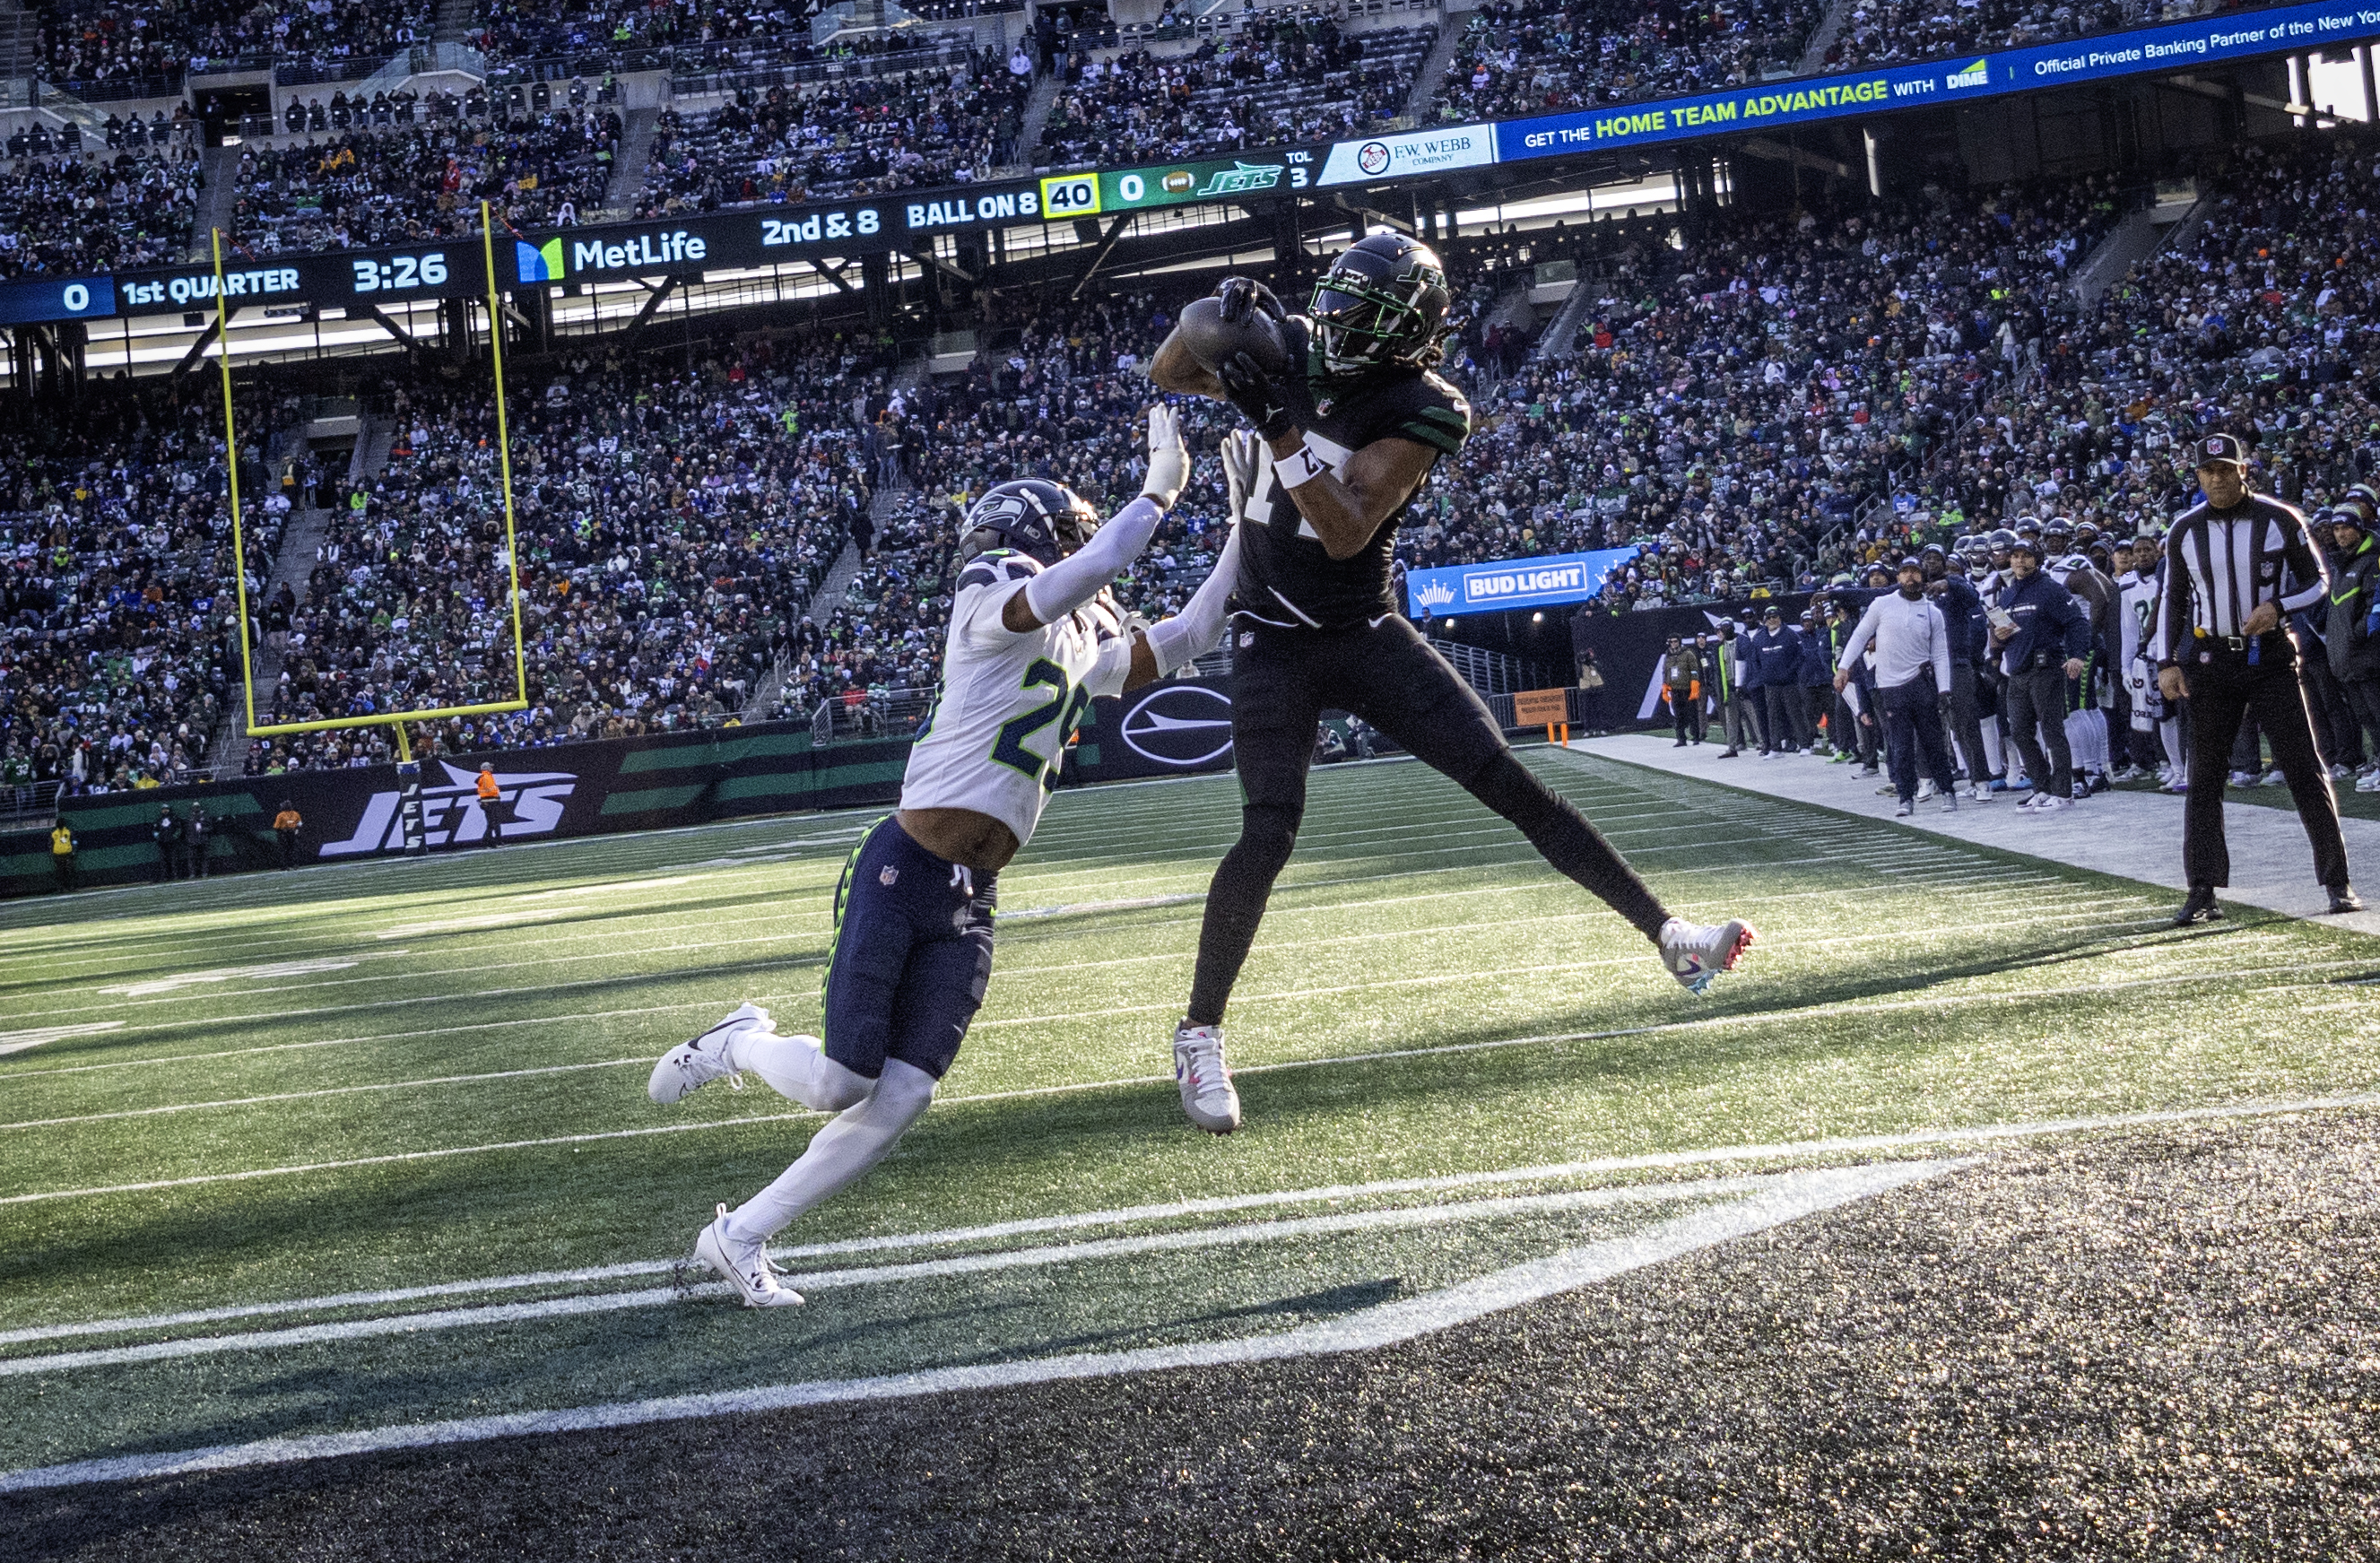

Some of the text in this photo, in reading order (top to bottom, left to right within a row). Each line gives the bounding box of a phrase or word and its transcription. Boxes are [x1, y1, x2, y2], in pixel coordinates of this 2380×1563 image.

[2034, 55, 2086, 75] Official
[2089, 48, 2141, 67] Private
[2144, 39, 2206, 58] Banking
[2210, 30, 2265, 48] Partner
[2269, 22, 2285, 39] of
[2288, 21, 2314, 36] the
[2317, 14, 2354, 31] New
[1524, 70, 1989, 148] GET THE HOME TEAM ADVANTAGE WITH DIME
[1285, 152, 1314, 165] TOL
[1394, 136, 1472, 160] F.W. WEBB
[1411, 153, 1455, 167] COMPANY
[1050, 183, 1092, 208] 40
[1119, 174, 1145, 202] 0
[1196, 160, 1285, 196] JETS
[1290, 167, 1309, 189] 3
[761, 209, 881, 247] 2nd & 8
[907, 191, 1038, 229] BALL ON 8
[574, 231, 707, 272] MetLife
[122, 268, 300, 305] 1st QUARTER
[353, 253, 447, 293] 3:26
[63, 283, 91, 312] 0
[1468, 567, 1581, 597] BUD LIGHT
[318, 760, 578, 856] JETS
[402, 783, 424, 849] JETS
